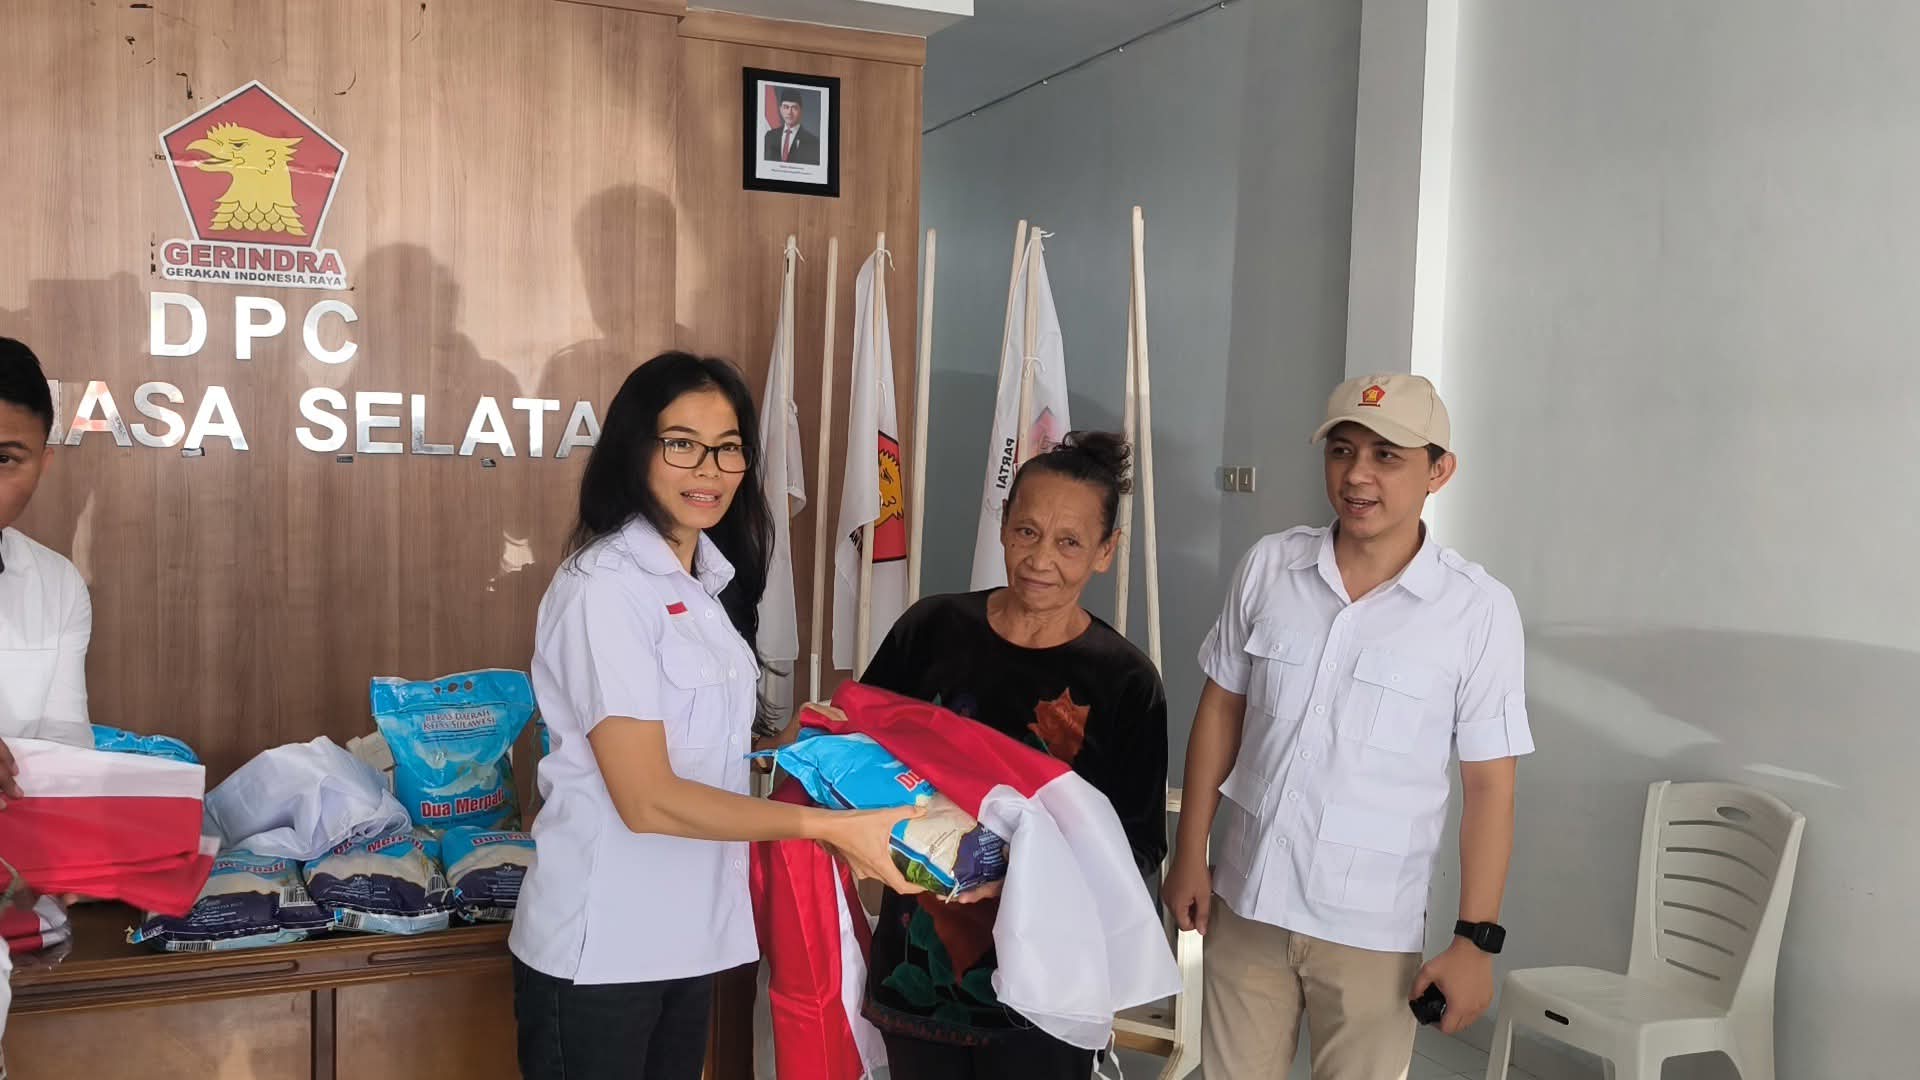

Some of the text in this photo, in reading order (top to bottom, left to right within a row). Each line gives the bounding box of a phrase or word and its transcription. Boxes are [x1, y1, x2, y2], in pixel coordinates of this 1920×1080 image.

[164, 242, 341, 275] GERINDRA
[166, 267, 341, 286] GERAKAN INDONESIA RAYA
[46, 380, 249, 452] ASA
[421, 800, 452, 819] Dua
